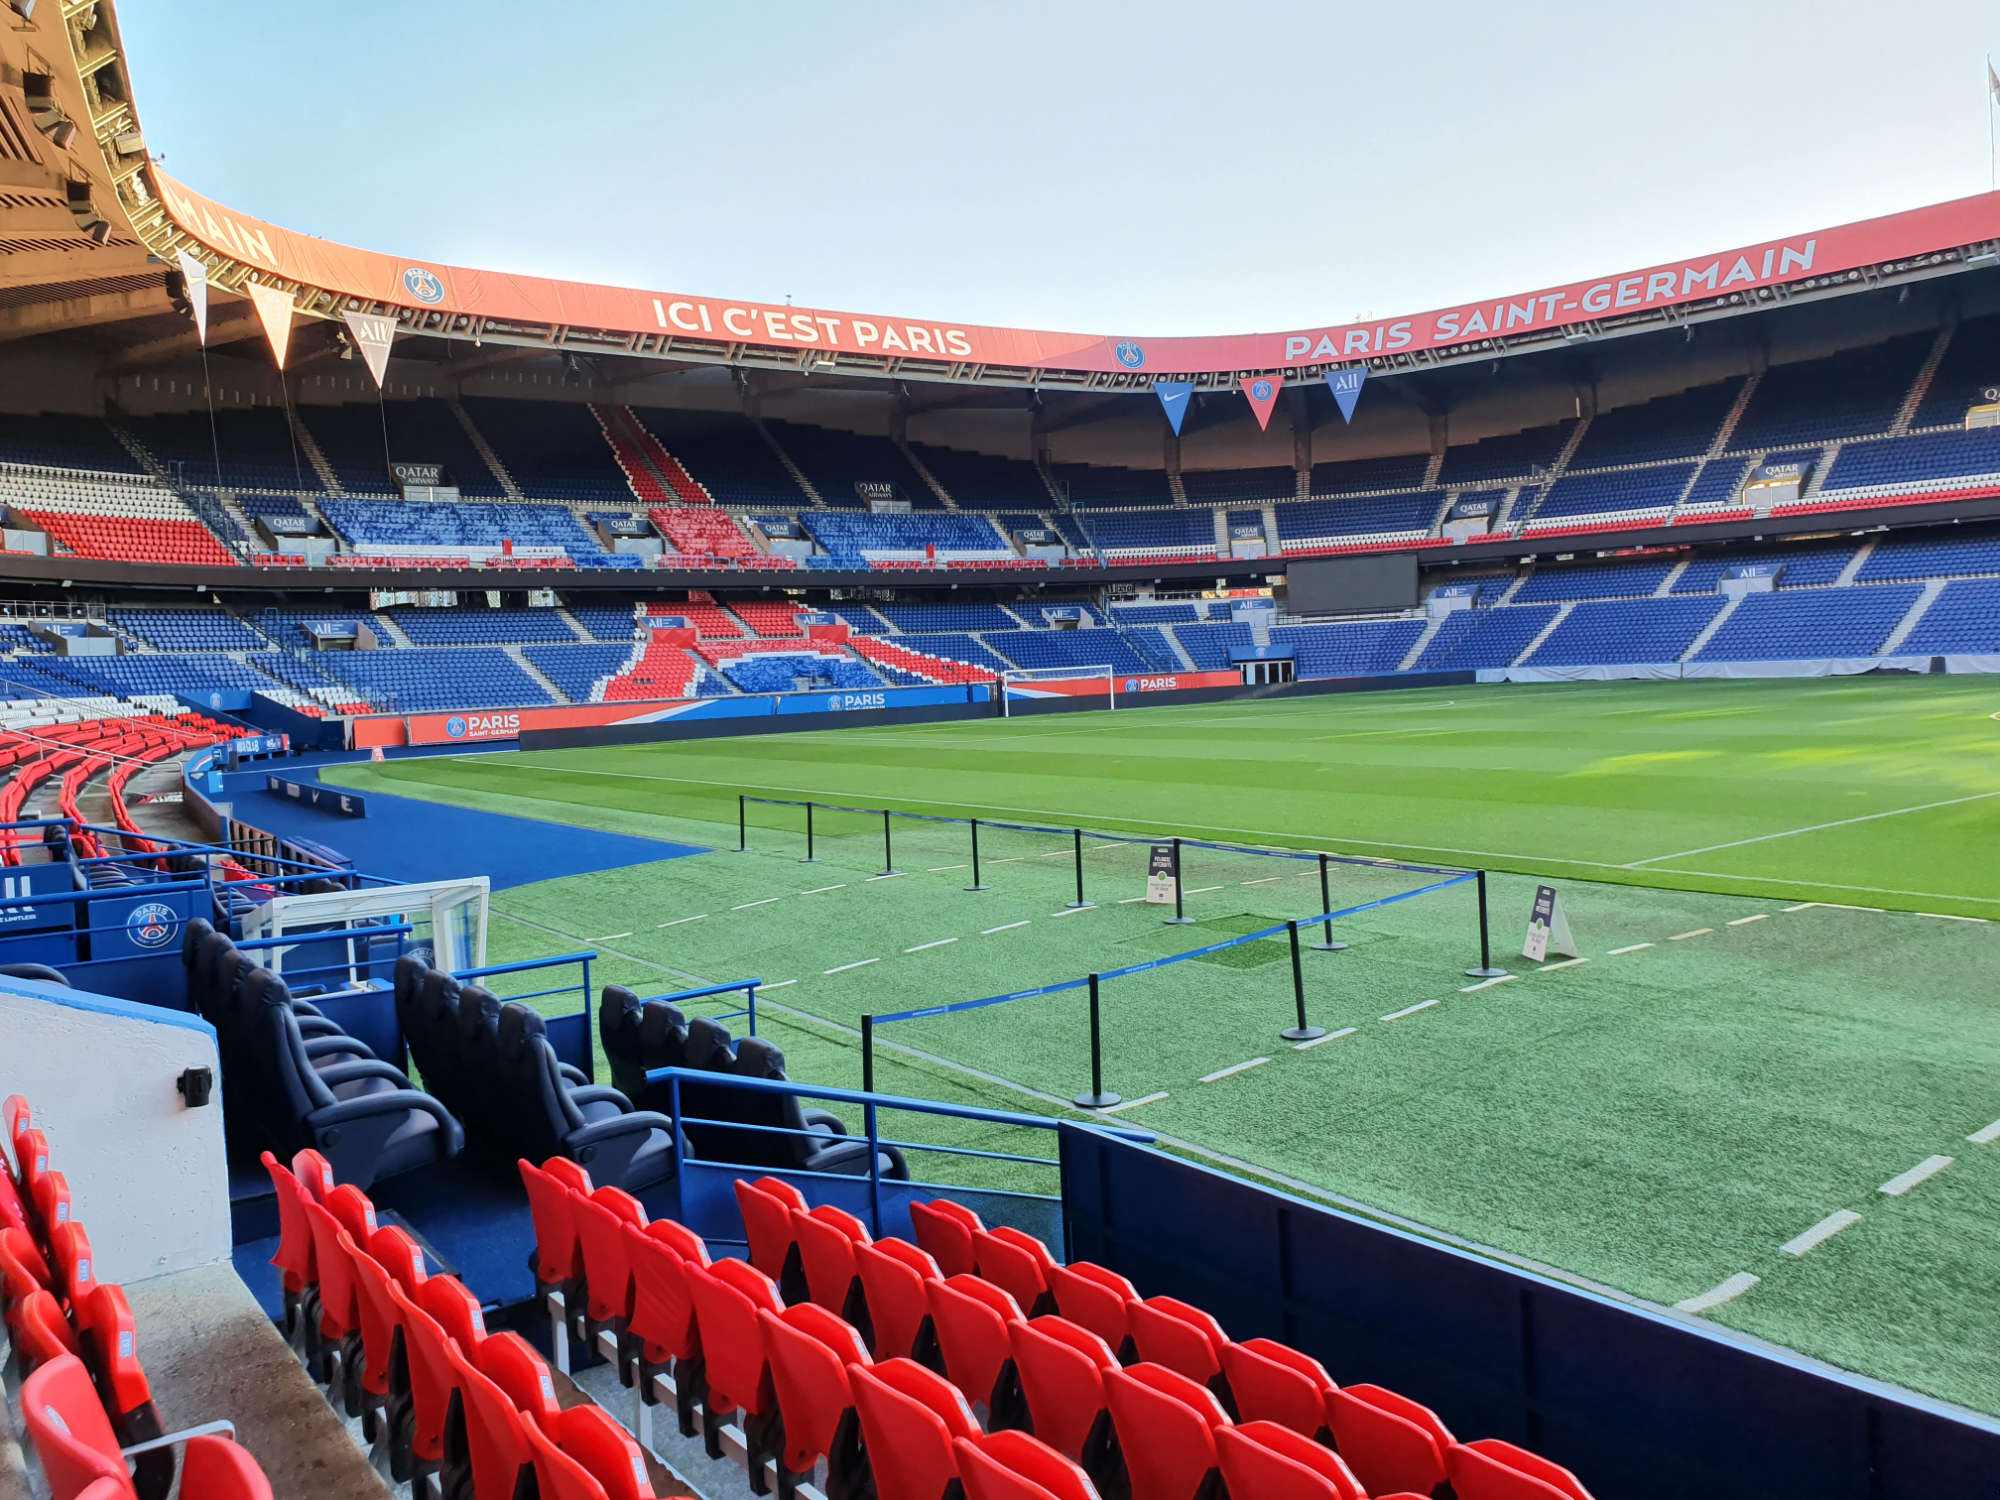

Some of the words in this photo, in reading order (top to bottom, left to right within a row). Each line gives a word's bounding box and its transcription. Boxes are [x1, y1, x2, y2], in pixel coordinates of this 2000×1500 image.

[1285, 321, 1413, 361] PARIS
[1433, 239, 1816, 341] SAINT-GERMAIN
[652, 299, 713, 333] ICI
[722, 308, 841, 345] C'EST
[852, 319, 972, 357] PARIS
[395, 466, 439, 479] QATAR
[1765, 463, 1799, 476] QATAR
[859, 483, 892, 494] QATAR
[1460, 502, 1488, 513] QATAR
[273, 518, 305, 528] QATAR
[611, 520, 637, 529] QATAR
[765, 524, 789, 533] QATAR
[1023, 531, 1045, 539] QATAR
[1234, 527, 1258, 536] QATAR
[1140, 677, 1177, 689] PARIS
[845, 693, 886, 706] PARIS
[468, 714, 520, 730] PARIS
[135, 904, 168, 918] PARIS
